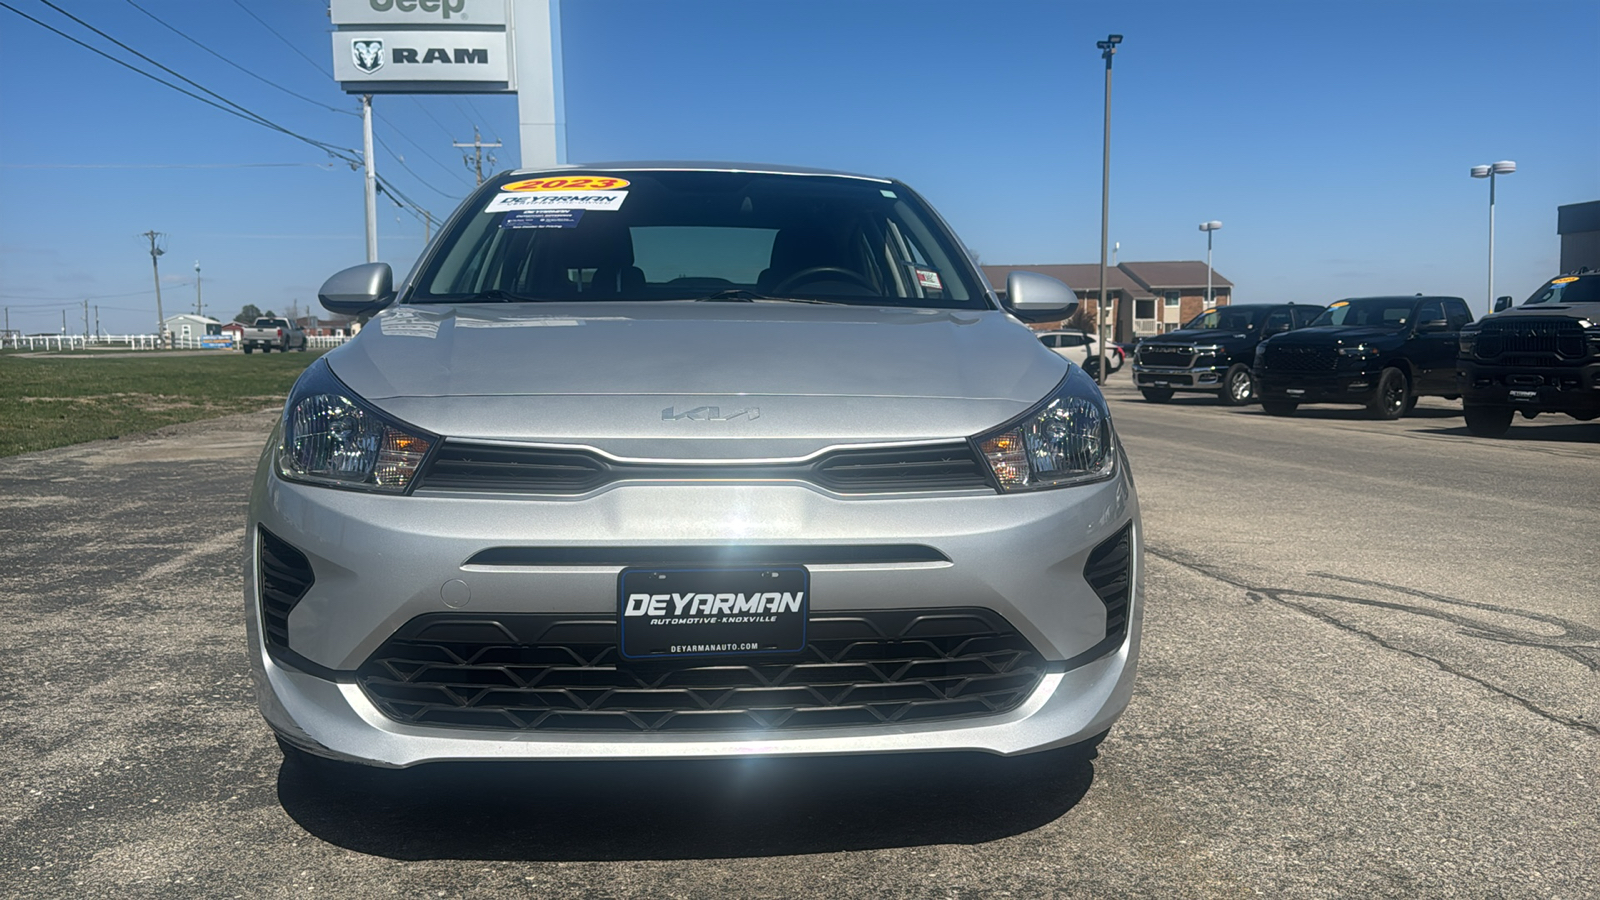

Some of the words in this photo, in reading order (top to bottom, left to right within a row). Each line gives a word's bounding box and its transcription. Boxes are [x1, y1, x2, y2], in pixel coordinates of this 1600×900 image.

[392, 48, 489, 64] RAM
[513, 179, 618, 189] 2023
[500, 196, 617, 204] DEYARMAN
[624, 592, 804, 616] DEYARMAN
[671, 643, 758, 653] DEYARMANAUTO.COM
